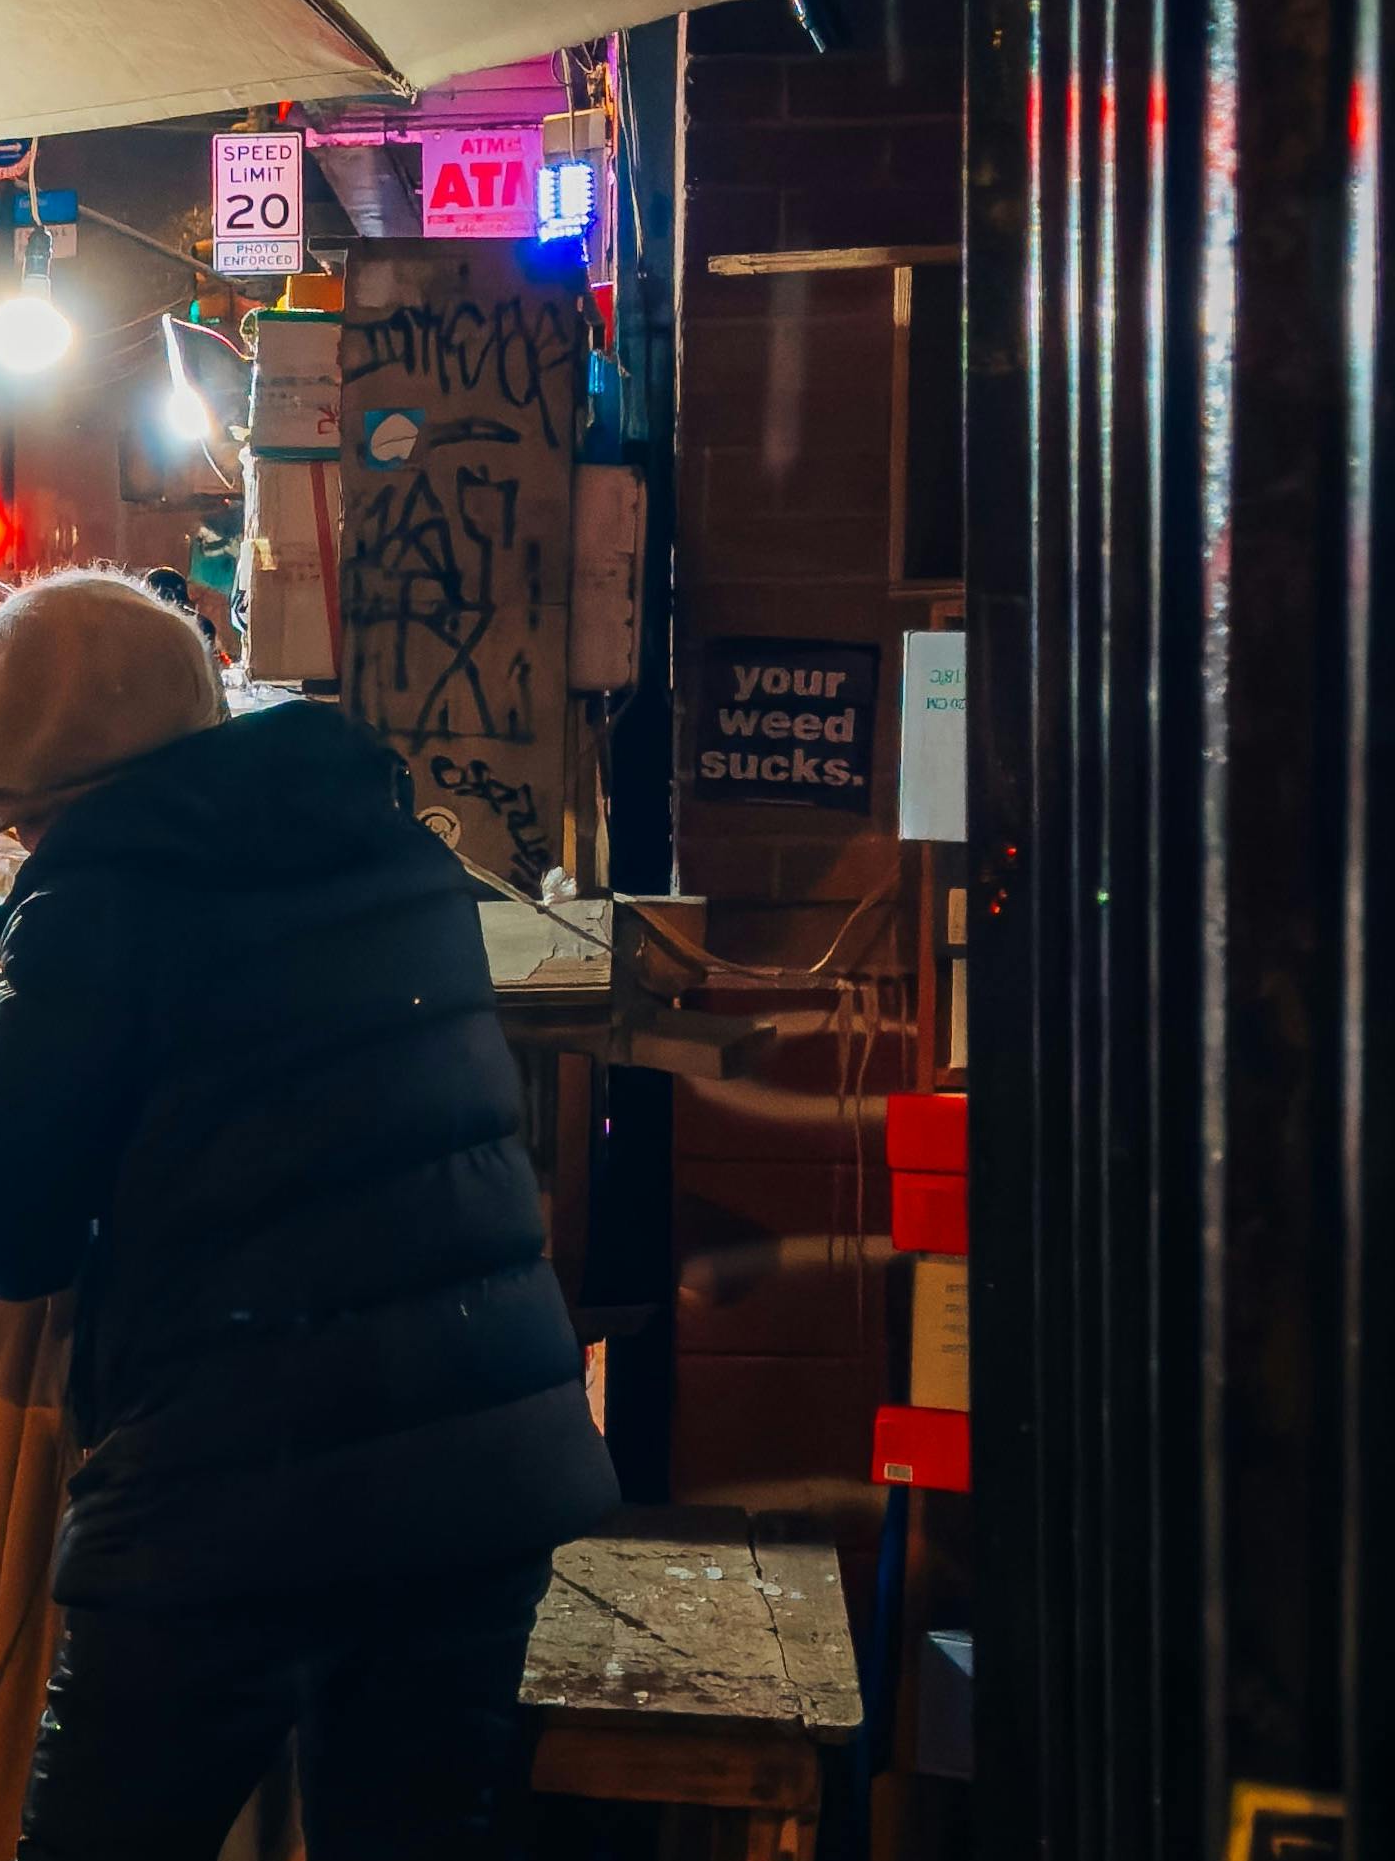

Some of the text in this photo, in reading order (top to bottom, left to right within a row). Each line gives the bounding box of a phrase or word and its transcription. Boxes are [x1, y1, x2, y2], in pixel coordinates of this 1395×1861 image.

[224, 145, 292, 161] SPEED
[231, 167, 286, 183] LIMIT
[226, 193, 289, 229] 20
[223, 255, 292, 267] ENFORCED
[236, 243, 279, 254] PHOTO
[733, 665, 846, 701] your
[719, 707, 856, 743] weed
[700, 748, 864, 787] sucks.
